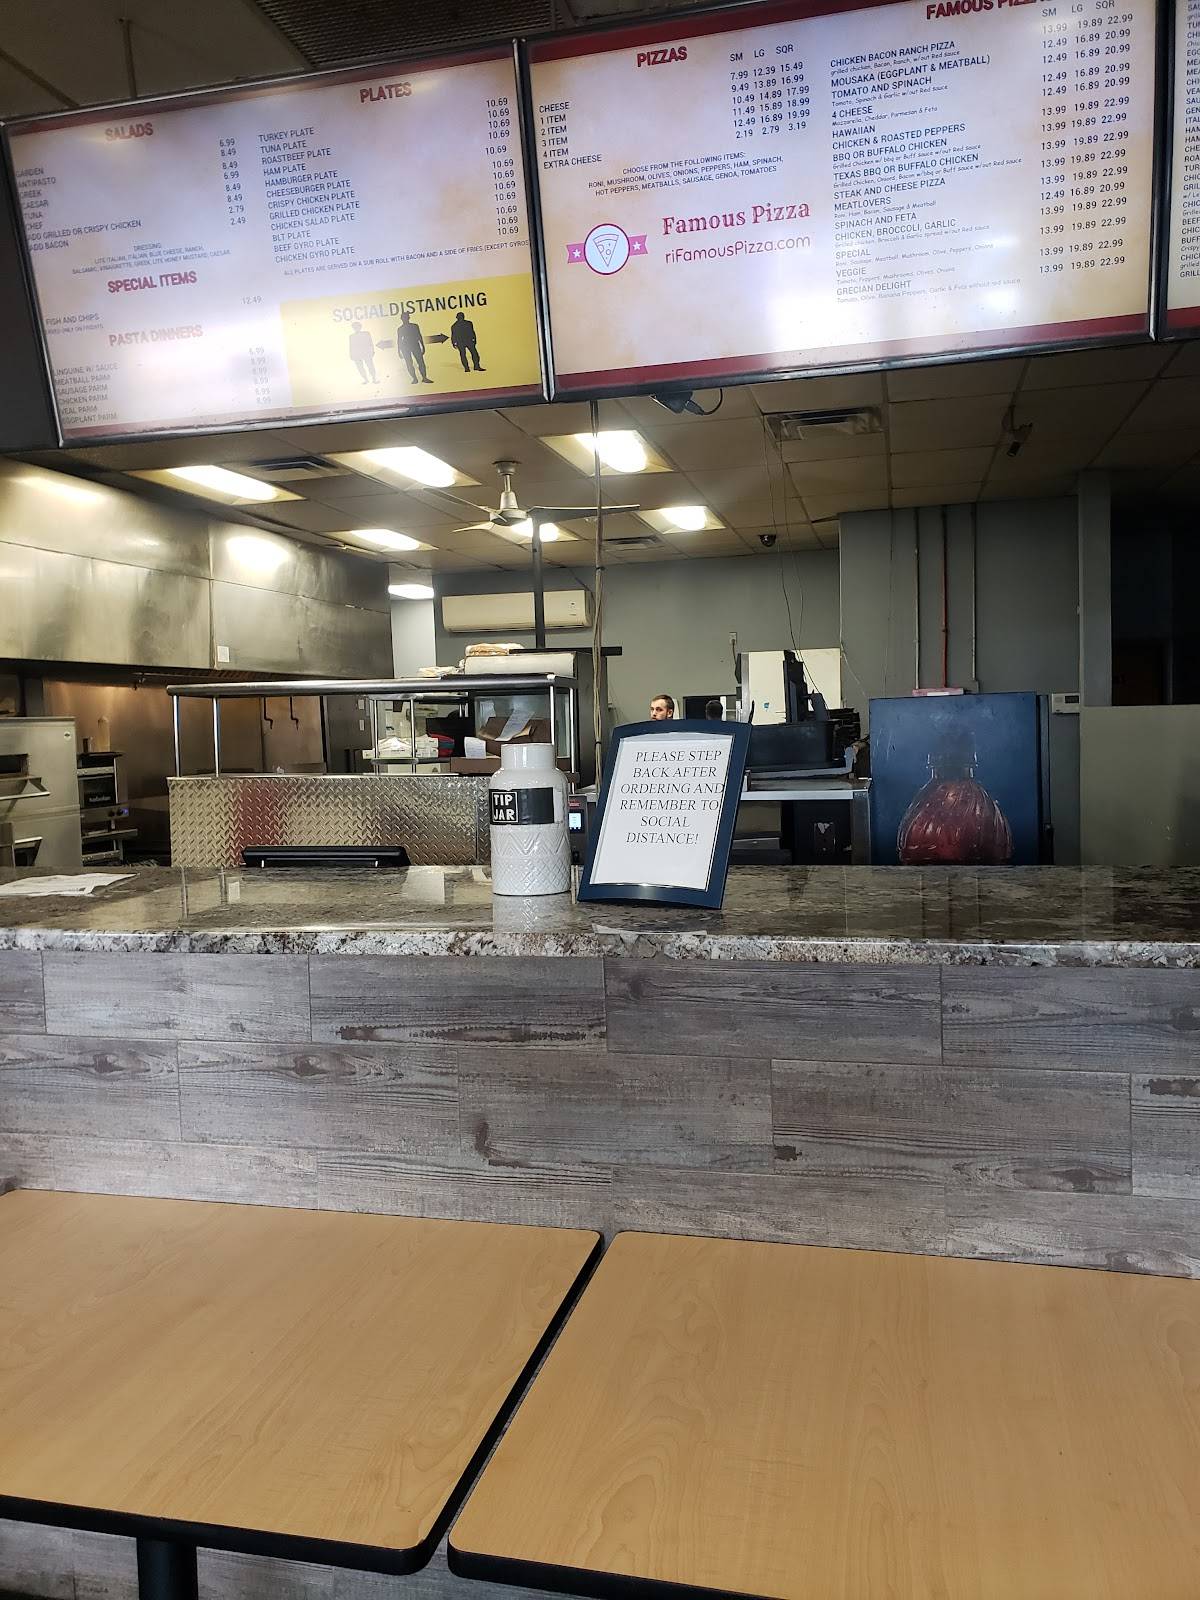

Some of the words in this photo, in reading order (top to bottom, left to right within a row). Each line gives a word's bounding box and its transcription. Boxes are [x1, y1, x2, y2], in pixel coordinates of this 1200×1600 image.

[926, 0, 994, 19] FAMOUS
[1042, 8, 1057, 17] SM
[1072, 4, 1083, 13] LG
[1043, 24, 1067, 34] 13.99
[1078, 18, 1103, 29] 19.89
[1107, 13, 1133, 24] 22.99
[1043, 38, 1067, 49] 12.49
[1075, 33, 1100, 44] 16.89
[1105, 29, 1130, 40] 20.99
[637, 46, 688, 67] PIZZAS
[730, 53, 743, 61] SM
[754, 49, 765, 58] LG
[776, 44, 794, 54] SQR
[830, 54, 866, 68] CHICKEN
[869, 50, 897, 63] BACON
[900, 45, 929, 57] RANCH
[931, 41, 955, 52] PIZZA
[730, 71, 748, 80] 7.99
[753, 66, 776, 77] 12.39
[780, 62, 803, 72] 15.49
[831, 73, 875, 88] MOUSAKA
[877, 65, 927, 82] (EGGPLANT
[930, 63, 936, 71] &
[939, 54, 991, 71] MEATBALL)
[731, 83, 749, 92] 9.49
[754, 79, 776, 89] 13.89
[781, 74, 804, 85] 16.99
[832, 87, 869, 99] TOMATO
[871, 83, 889, 93] AND
[892, 76, 932, 90] SPINACH
[360, 82, 412, 103] PLATES
[733, 94, 755, 104] 10.49
[760, 90, 782, 100] 14.89
[787, 85, 809, 96] 17.99
[486, 98, 508, 108] 10.69
[539, 101, 570, 113] CHEESE
[488, 108, 510, 119] 10.69
[832, 111, 837, 119] 4
[839, 106, 873, 118] CHEESE
[105, 122, 154, 142] SALADS
[259, 131, 288, 143] TURKEY
[291, 127, 314, 138] PLATE
[736, 129, 753, 138] 2.19
[762, 125, 779, 135] 2.79
[789, 121, 806, 131] 3.19
[832, 125, 876, 139] HAWAIIAN
[833, 137, 870, 150] CHICKEN
[873, 136, 878, 144] &
[881, 130, 922, 142] ROASTED
[924, 123, 966, 137] PEPPERS
[220, 138, 235, 147] 6.99
[833, 153, 851, 162] BBQ
[853, 150, 865, 159] OR
[867, 144, 906, 157] BUFFALO
[908, 138, 947, 151] CHICKEN
[222, 161, 238, 169] 8.49
[262, 153, 305, 165] ROASTBEEF
[307, 148, 332, 159] PLATE
[492, 159, 514, 169] 10.69
[544, 159, 570, 169] EXTRA
[572, 154, 602, 165] CHEESE
[622, 165, 649, 175] CHOOSE
[650, 162, 668, 171] FROM
[671, 160, 683, 168] THE
[684, 155, 722, 167] FOLLOWING
[723, 151, 746, 160] ITEMS:
[588, 179, 606, 189] RONI,
[606, 174, 647, 187] MUSHROOM,
[647, 171, 672, 180] OLIVES,
[673, 167, 700, 177] ONIONS,
[701, 163, 732, 174] PEPPERS,
[733, 160, 751, 169] HAM,
[752, 156, 784, 167] SPINACH,
[833, 170, 861, 181] TEXAS
[863, 167, 881, 178] BBQ
[883, 164, 895, 174] OR
[898, 159, 937, 172] BUFFALO
[939, 154, 979, 167] CHICKEN
[265, 172, 313, 187] HAMBURGER
[315, 170, 338, 180] PLATE
[610, 184, 641, 195] PEPPERS,
[641, 179, 681, 190] MEATBALLS,
[682, 174, 714, 185] SAUSAGE,
[715, 171, 739, 180] GENOA,
[741, 166, 777, 178] TOMATOES
[267, 184, 325, 198] CHEESEBURGER
[327, 180, 351, 190] PLATE
[833, 189, 862, 200] STEAK
[864, 187, 882, 196] AND
[884, 181, 918, 193] CHEESE
[920, 177, 946, 188] PIZZA
[1041, 190, 1065, 201] 12.49
[1070, 186, 1095, 197] 16.89
[1100, 181, 1125, 193] 20.99
[270, 210, 300, 220] GRILLED
[302, 205, 335, 216] CHICKEN
[336, 201, 360, 211] PLATE
[834, 196, 891, 211] MEATLOVERS
[497, 216, 518, 226] 10.69
[662, 209, 746, 235] Famous
[751, 202, 811, 224] Pizza
[43, 228, 71, 239] GRILLED
[73, 227, 82, 235] OR
[84, 224, 109, 234] CRISPY
[110, 219, 142, 231] CHICKEN
[273, 233, 286, 242] BLT
[288, 230, 311, 240] PLATE
[835, 230, 875, 241] CHICKEN,
[876, 224, 923, 236] BROCCOLI,
[924, 218, 956, 230] GARLIC
[665, 234, 811, 264] riFamousPizza.com
[1040, 264, 1063, 274] 13.99
[1071, 259, 1095, 270] 19.89
[1100, 256, 1125, 267] 22.99
[107, 275, 157, 294] SPECIAL
[160, 270, 197, 288] ITEMS
[46, 316, 62, 325] FISH
[63, 314, 77, 323] AND
[78, 313, 100, 322] CHIPS
[108, 329, 149, 347] PASTA
[151, 325, 203, 342] DINNERS
[636, 751, 685, 762] PLEASE
[688, 750, 722, 761] STEP
[633, 767, 670, 778] BACK
[672, 766, 717, 778] AFTER
[620, 783, 691, 794] ORDERING
[693, 783, 724, 794] AND
[493, 794, 513, 806] TIP
[620, 799, 696, 811] REMEMBER
[700, 799, 719, 811] TO
[493, 809, 515, 820] JAR
[640, 816, 690, 827] SOCIAL
[626, 832, 699, 844] DISTANCE!
